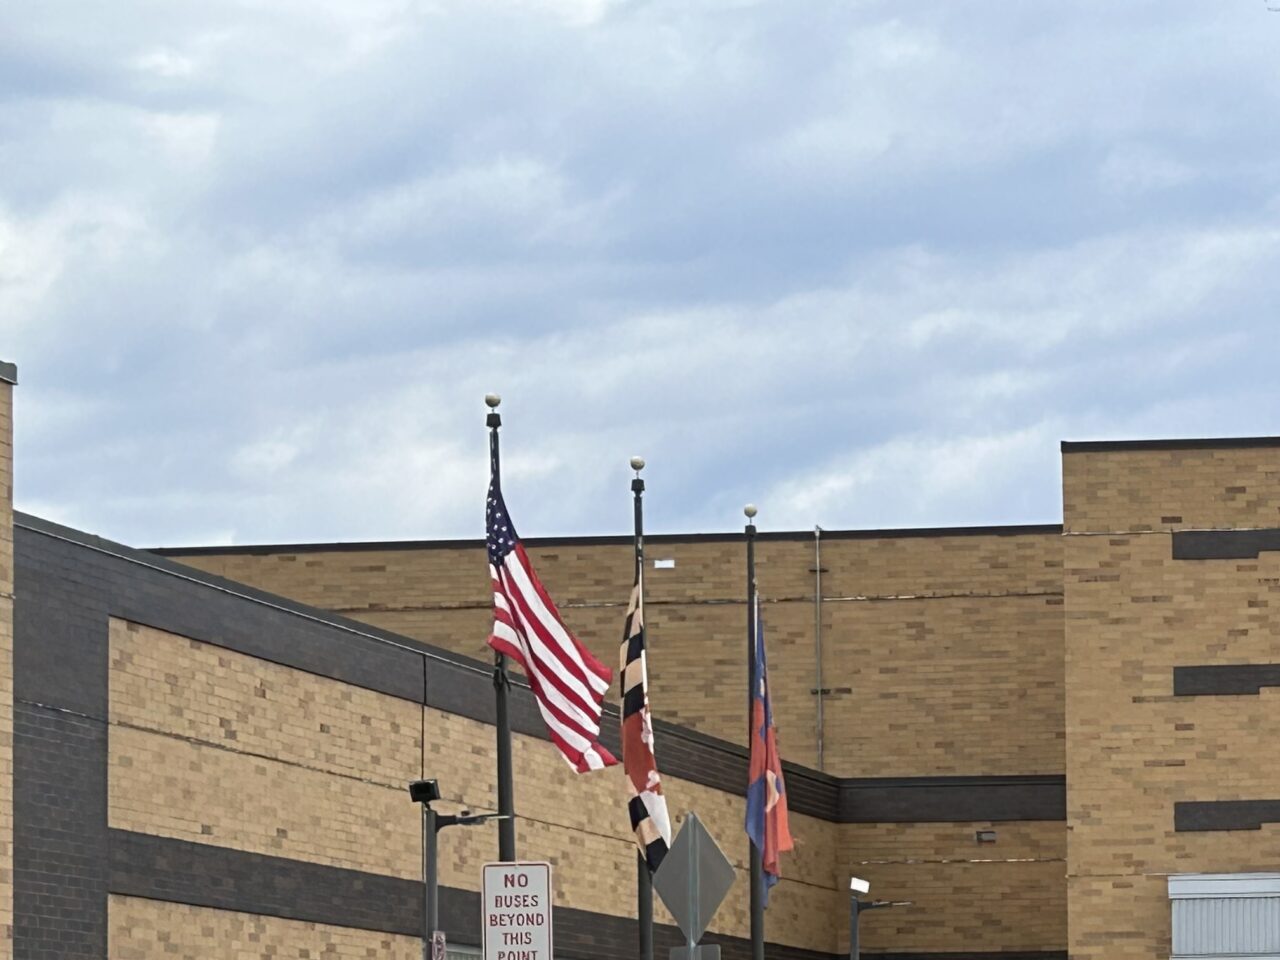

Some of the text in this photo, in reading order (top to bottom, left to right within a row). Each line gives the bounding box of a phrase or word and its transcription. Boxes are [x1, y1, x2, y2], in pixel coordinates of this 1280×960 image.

[504, 874, 528, 888] NO
[495, 895, 539, 908] BUSES
[489, 913, 545, 927] BEYOND
[502, 932, 532, 945] THIS
